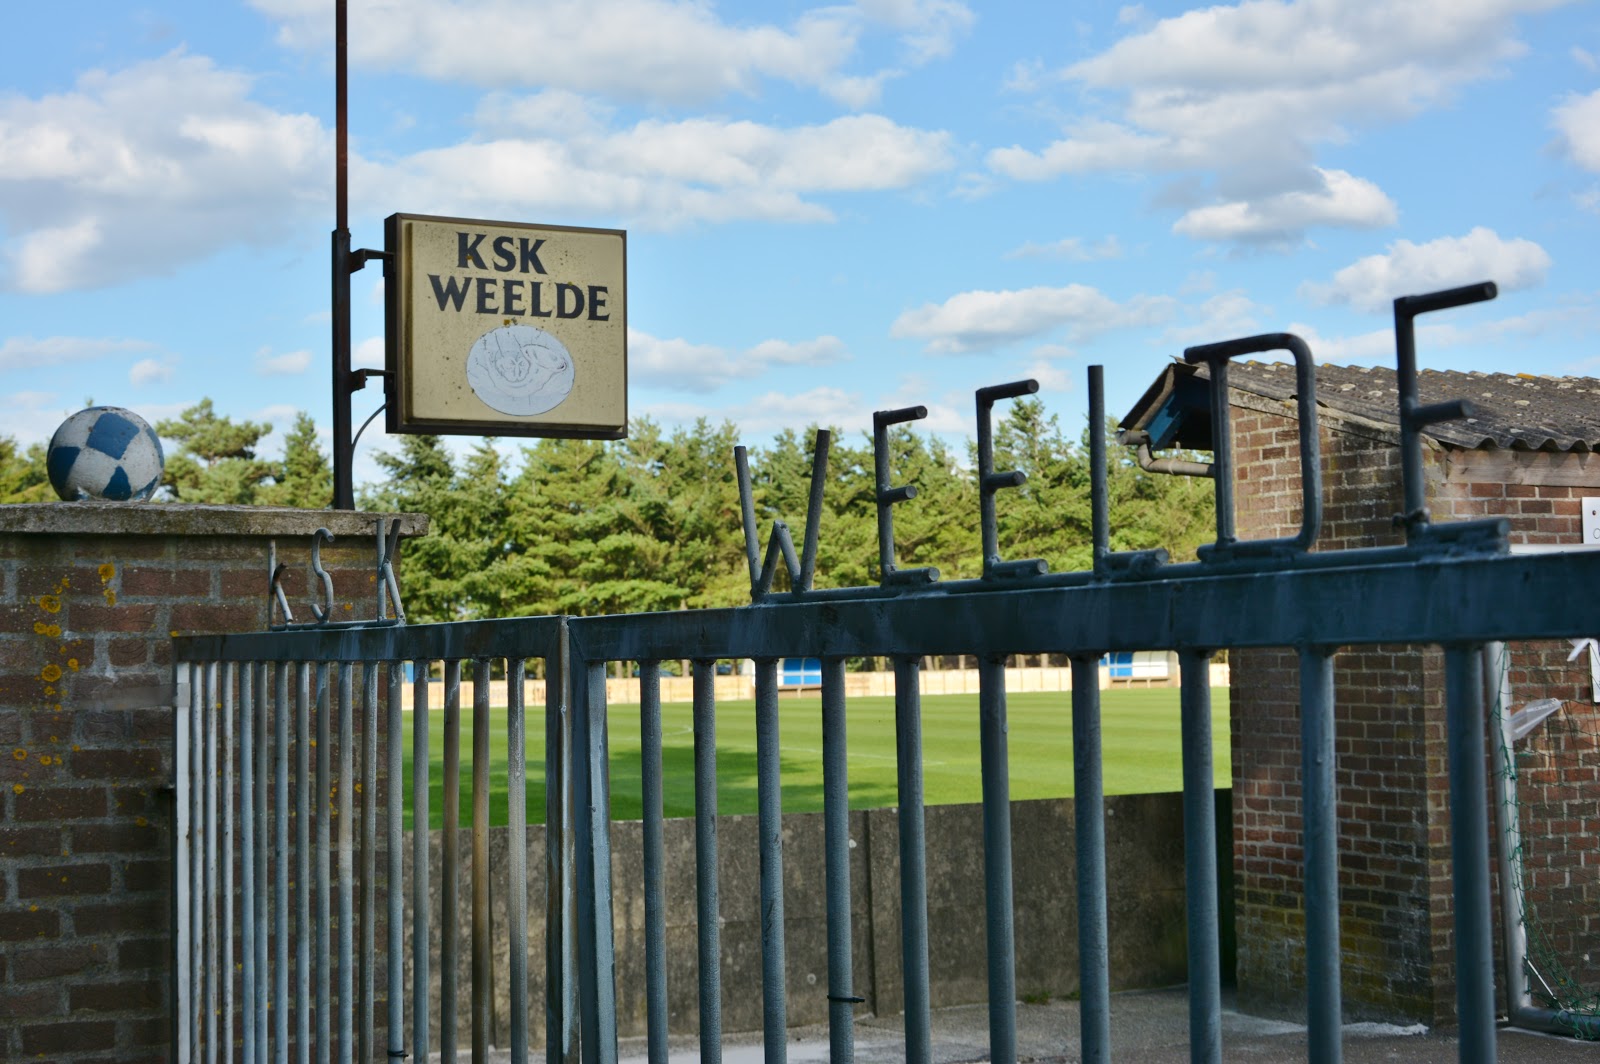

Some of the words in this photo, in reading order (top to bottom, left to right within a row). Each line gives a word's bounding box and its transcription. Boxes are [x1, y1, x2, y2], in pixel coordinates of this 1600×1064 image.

[456, 231, 548, 275] KSK
[427, 273, 611, 322] WEELDE
[268, 518, 407, 631] KSK
[733, 280, 1511, 602] WEELDE
